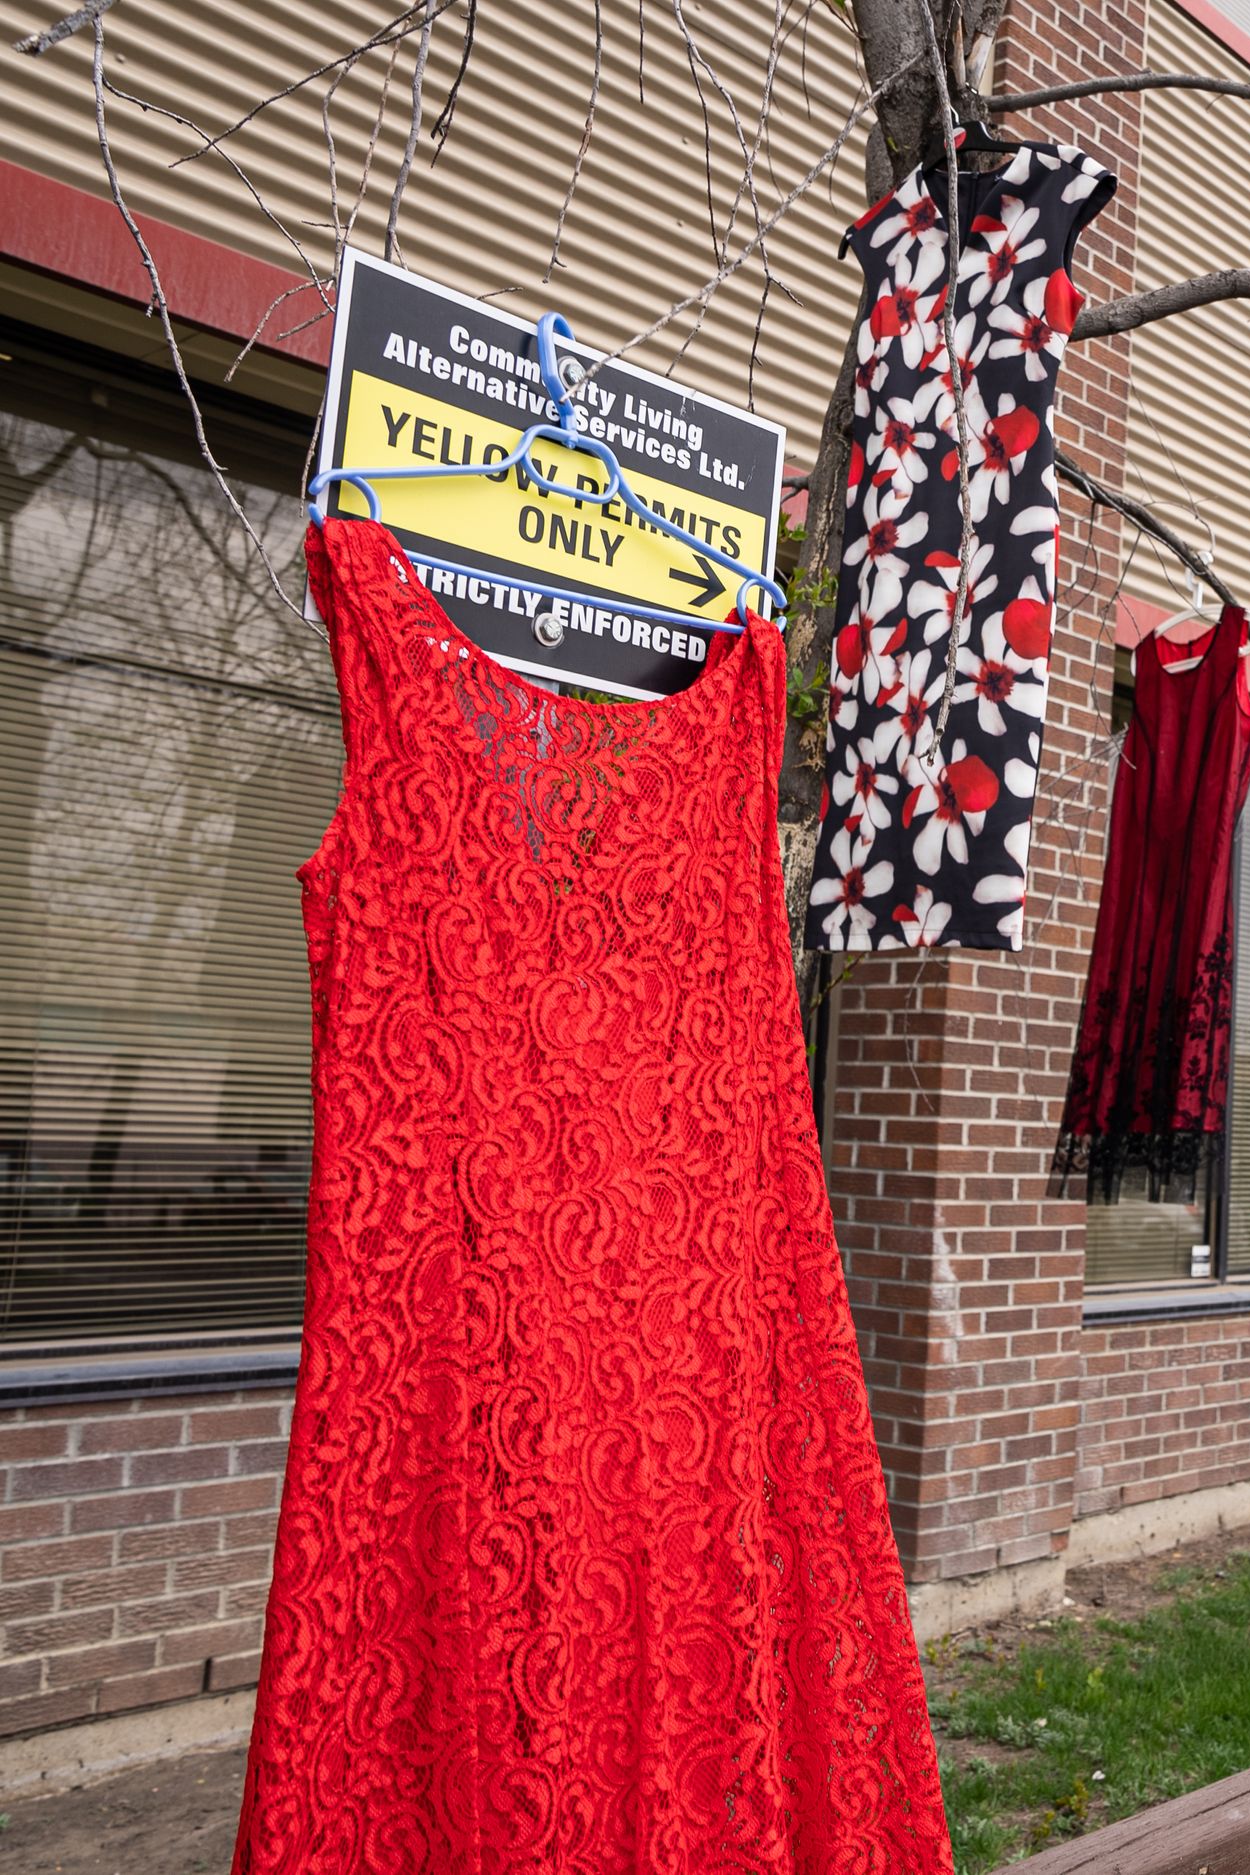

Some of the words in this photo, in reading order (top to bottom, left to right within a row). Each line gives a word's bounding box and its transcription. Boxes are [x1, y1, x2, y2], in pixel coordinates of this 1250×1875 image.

[383, 332, 561, 421] Alternative
[574, 405, 692, 470] Services
[699, 452, 745, 491] Ltd.
[449, 325, 616, 415] Commity
[624, 393, 704, 451] Living
[382, 405, 558, 499] YELLOW
[574, 474, 741, 559] PERMITS
[519, 505, 624, 568] ONLY
[552, 597, 706, 662] ENFORCED
